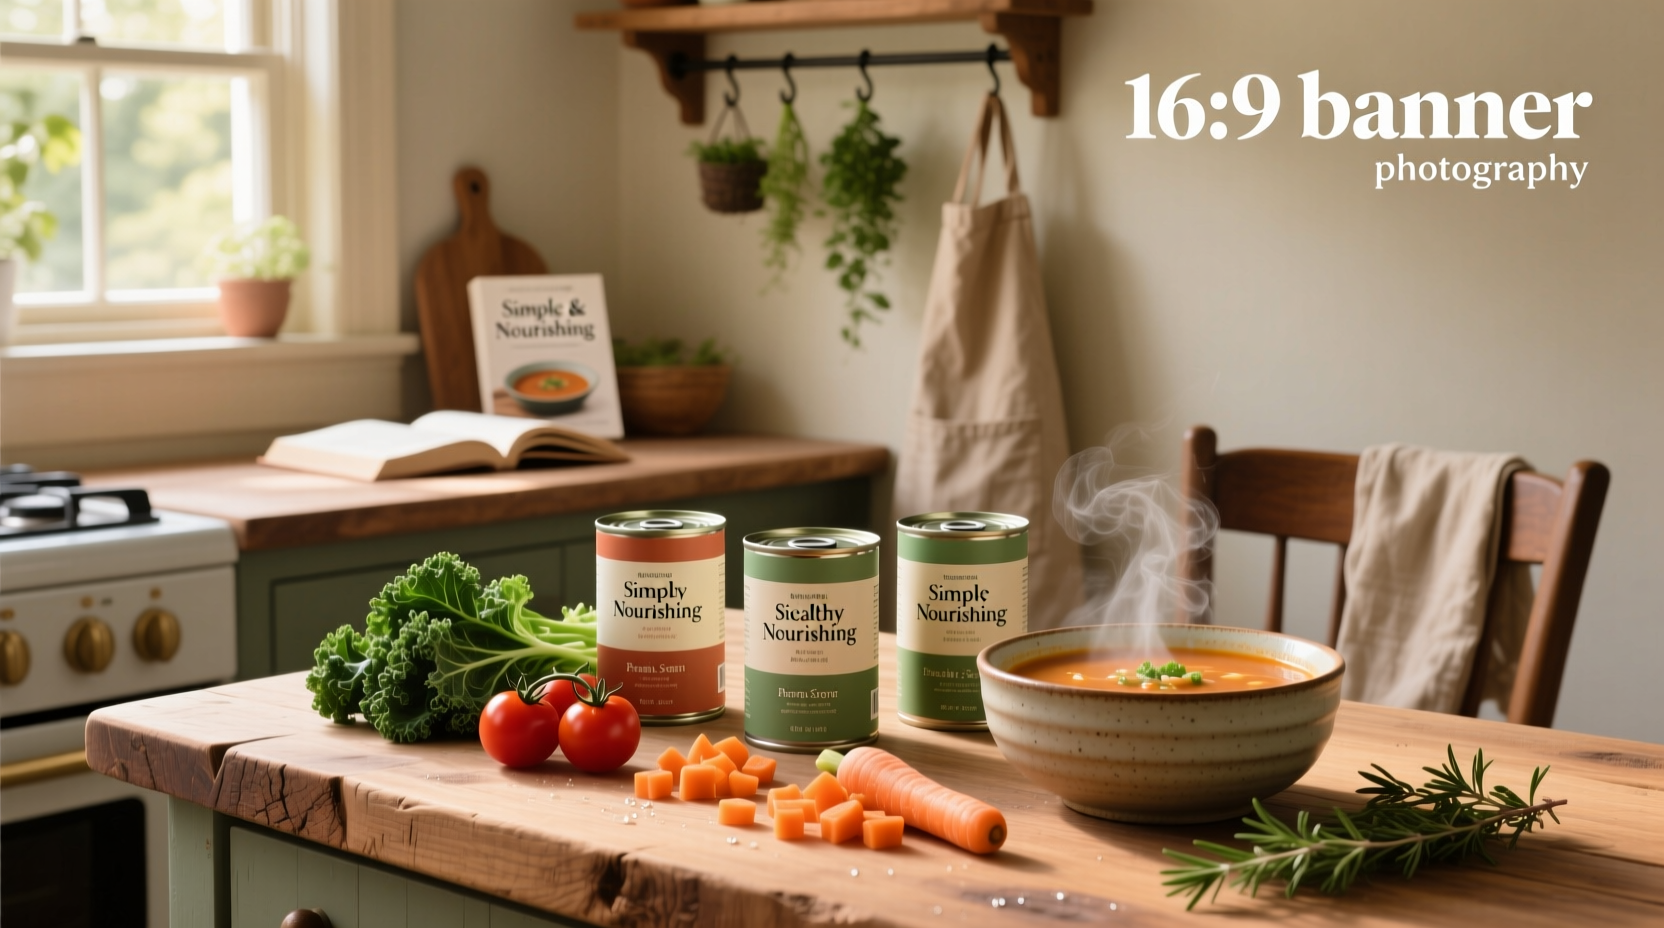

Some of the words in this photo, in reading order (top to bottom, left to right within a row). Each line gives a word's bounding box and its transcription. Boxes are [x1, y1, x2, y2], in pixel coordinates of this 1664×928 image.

[502, 297, 563, 320] Simple
[569, 298, 586, 316] &
[495, 319, 595, 341] Nourishing
[928, 584, 989, 607] Simple
[613, 600, 703, 623] Nourishing
[916, 603, 1008, 627] Nourishing
[762, 622, 857, 646] Nourishing
